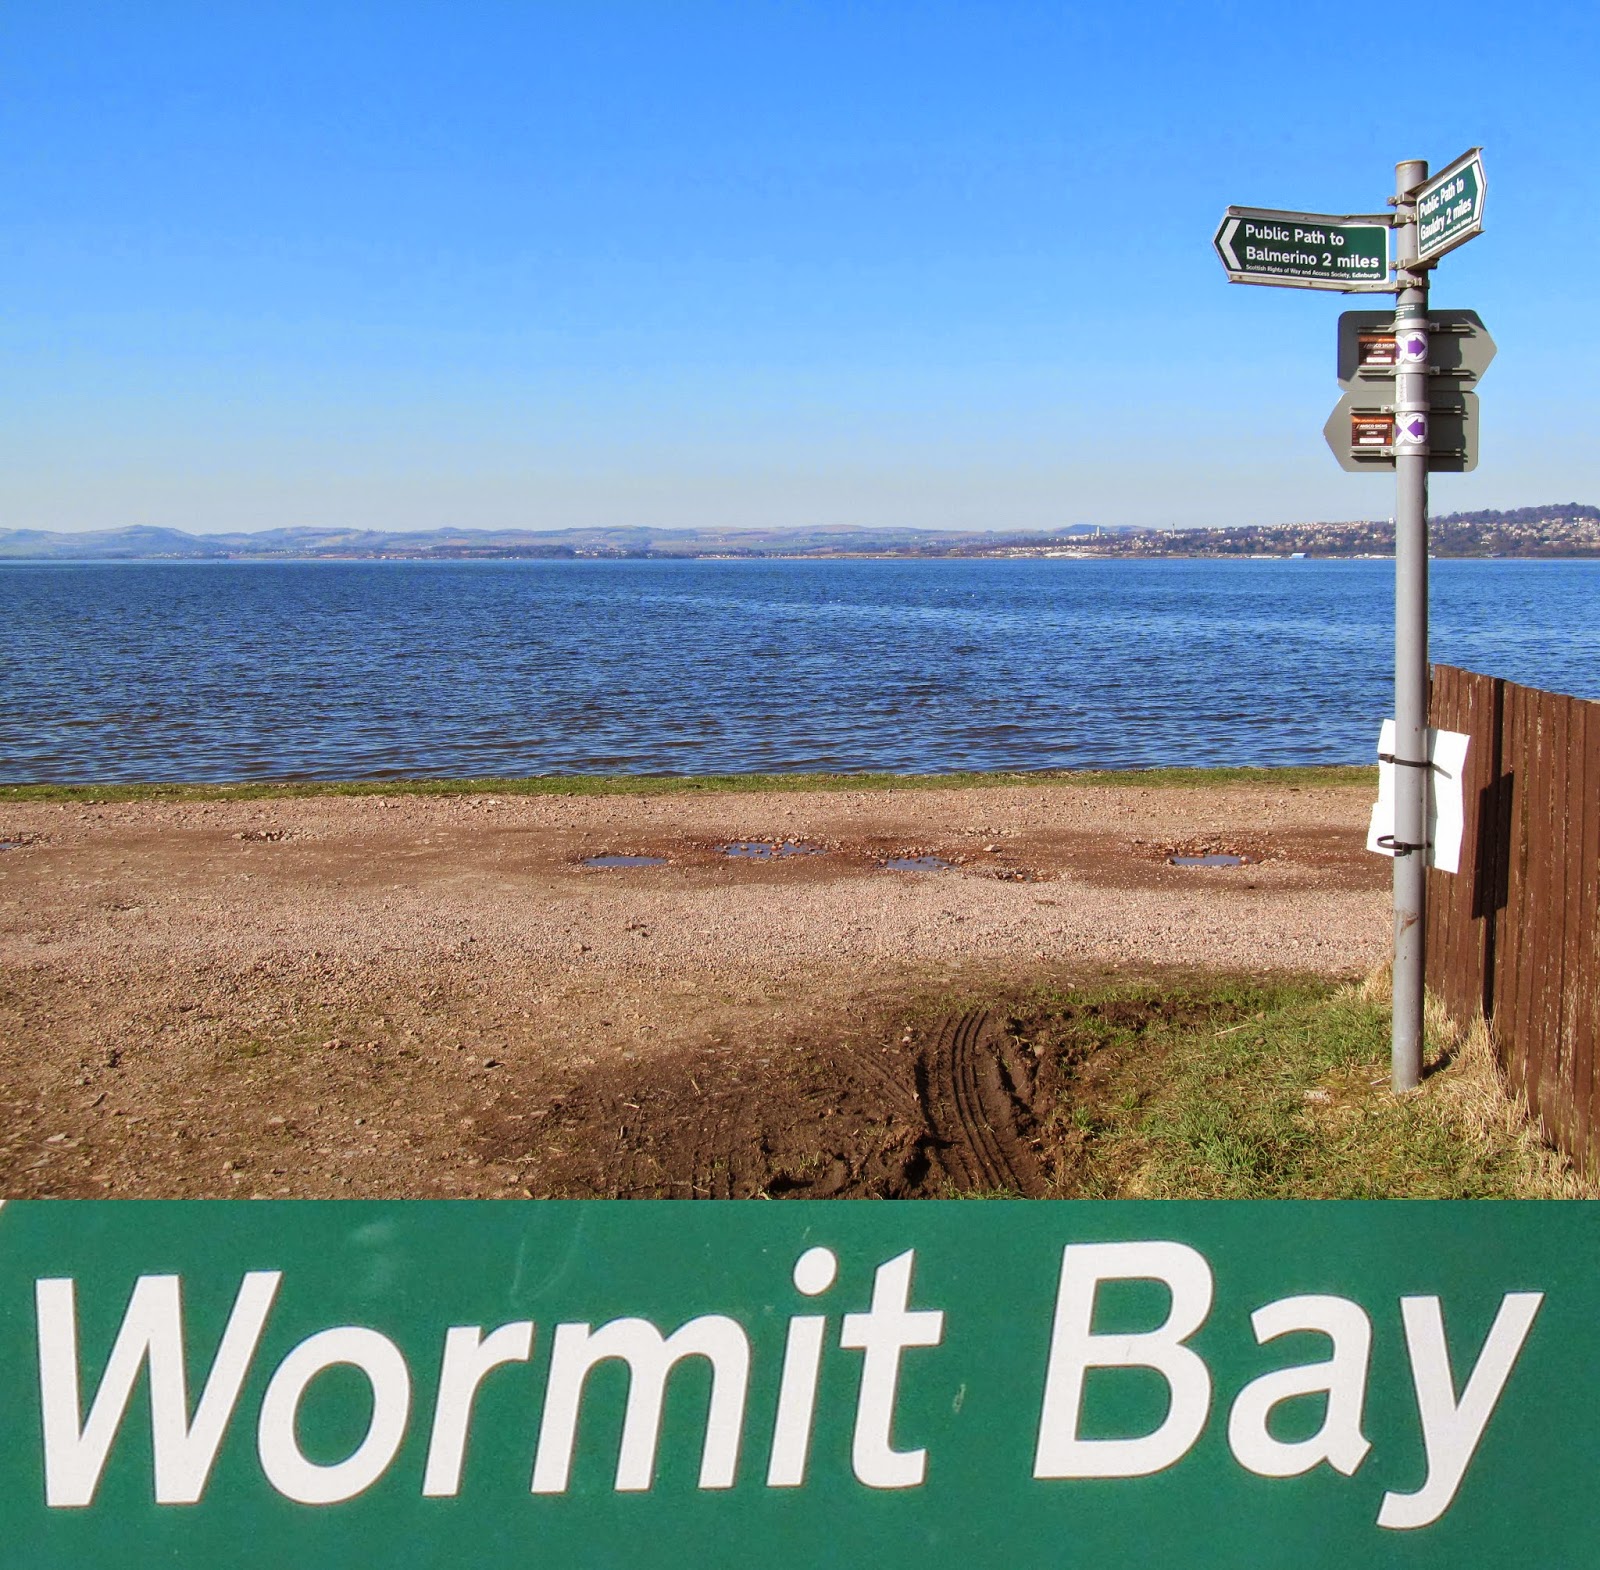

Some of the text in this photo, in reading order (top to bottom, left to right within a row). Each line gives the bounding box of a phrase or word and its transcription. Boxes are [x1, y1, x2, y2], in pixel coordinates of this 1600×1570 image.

[1420, 178, 1464, 218] Public Path to
[1421, 215, 1445, 240] Gauldry
[1446, 207, 1452, 223] 2
[1453, 198, 1472, 220] miles
[1245, 224, 1344, 246] Public Path to
[1246, 246, 1379, 268] Balmerino 2 miles
[1246, 264, 1267, 272] Scottish
[1268, 266, 1282, 274] Rights
[35, 1242, 1543, 1529] Wormit Bay
